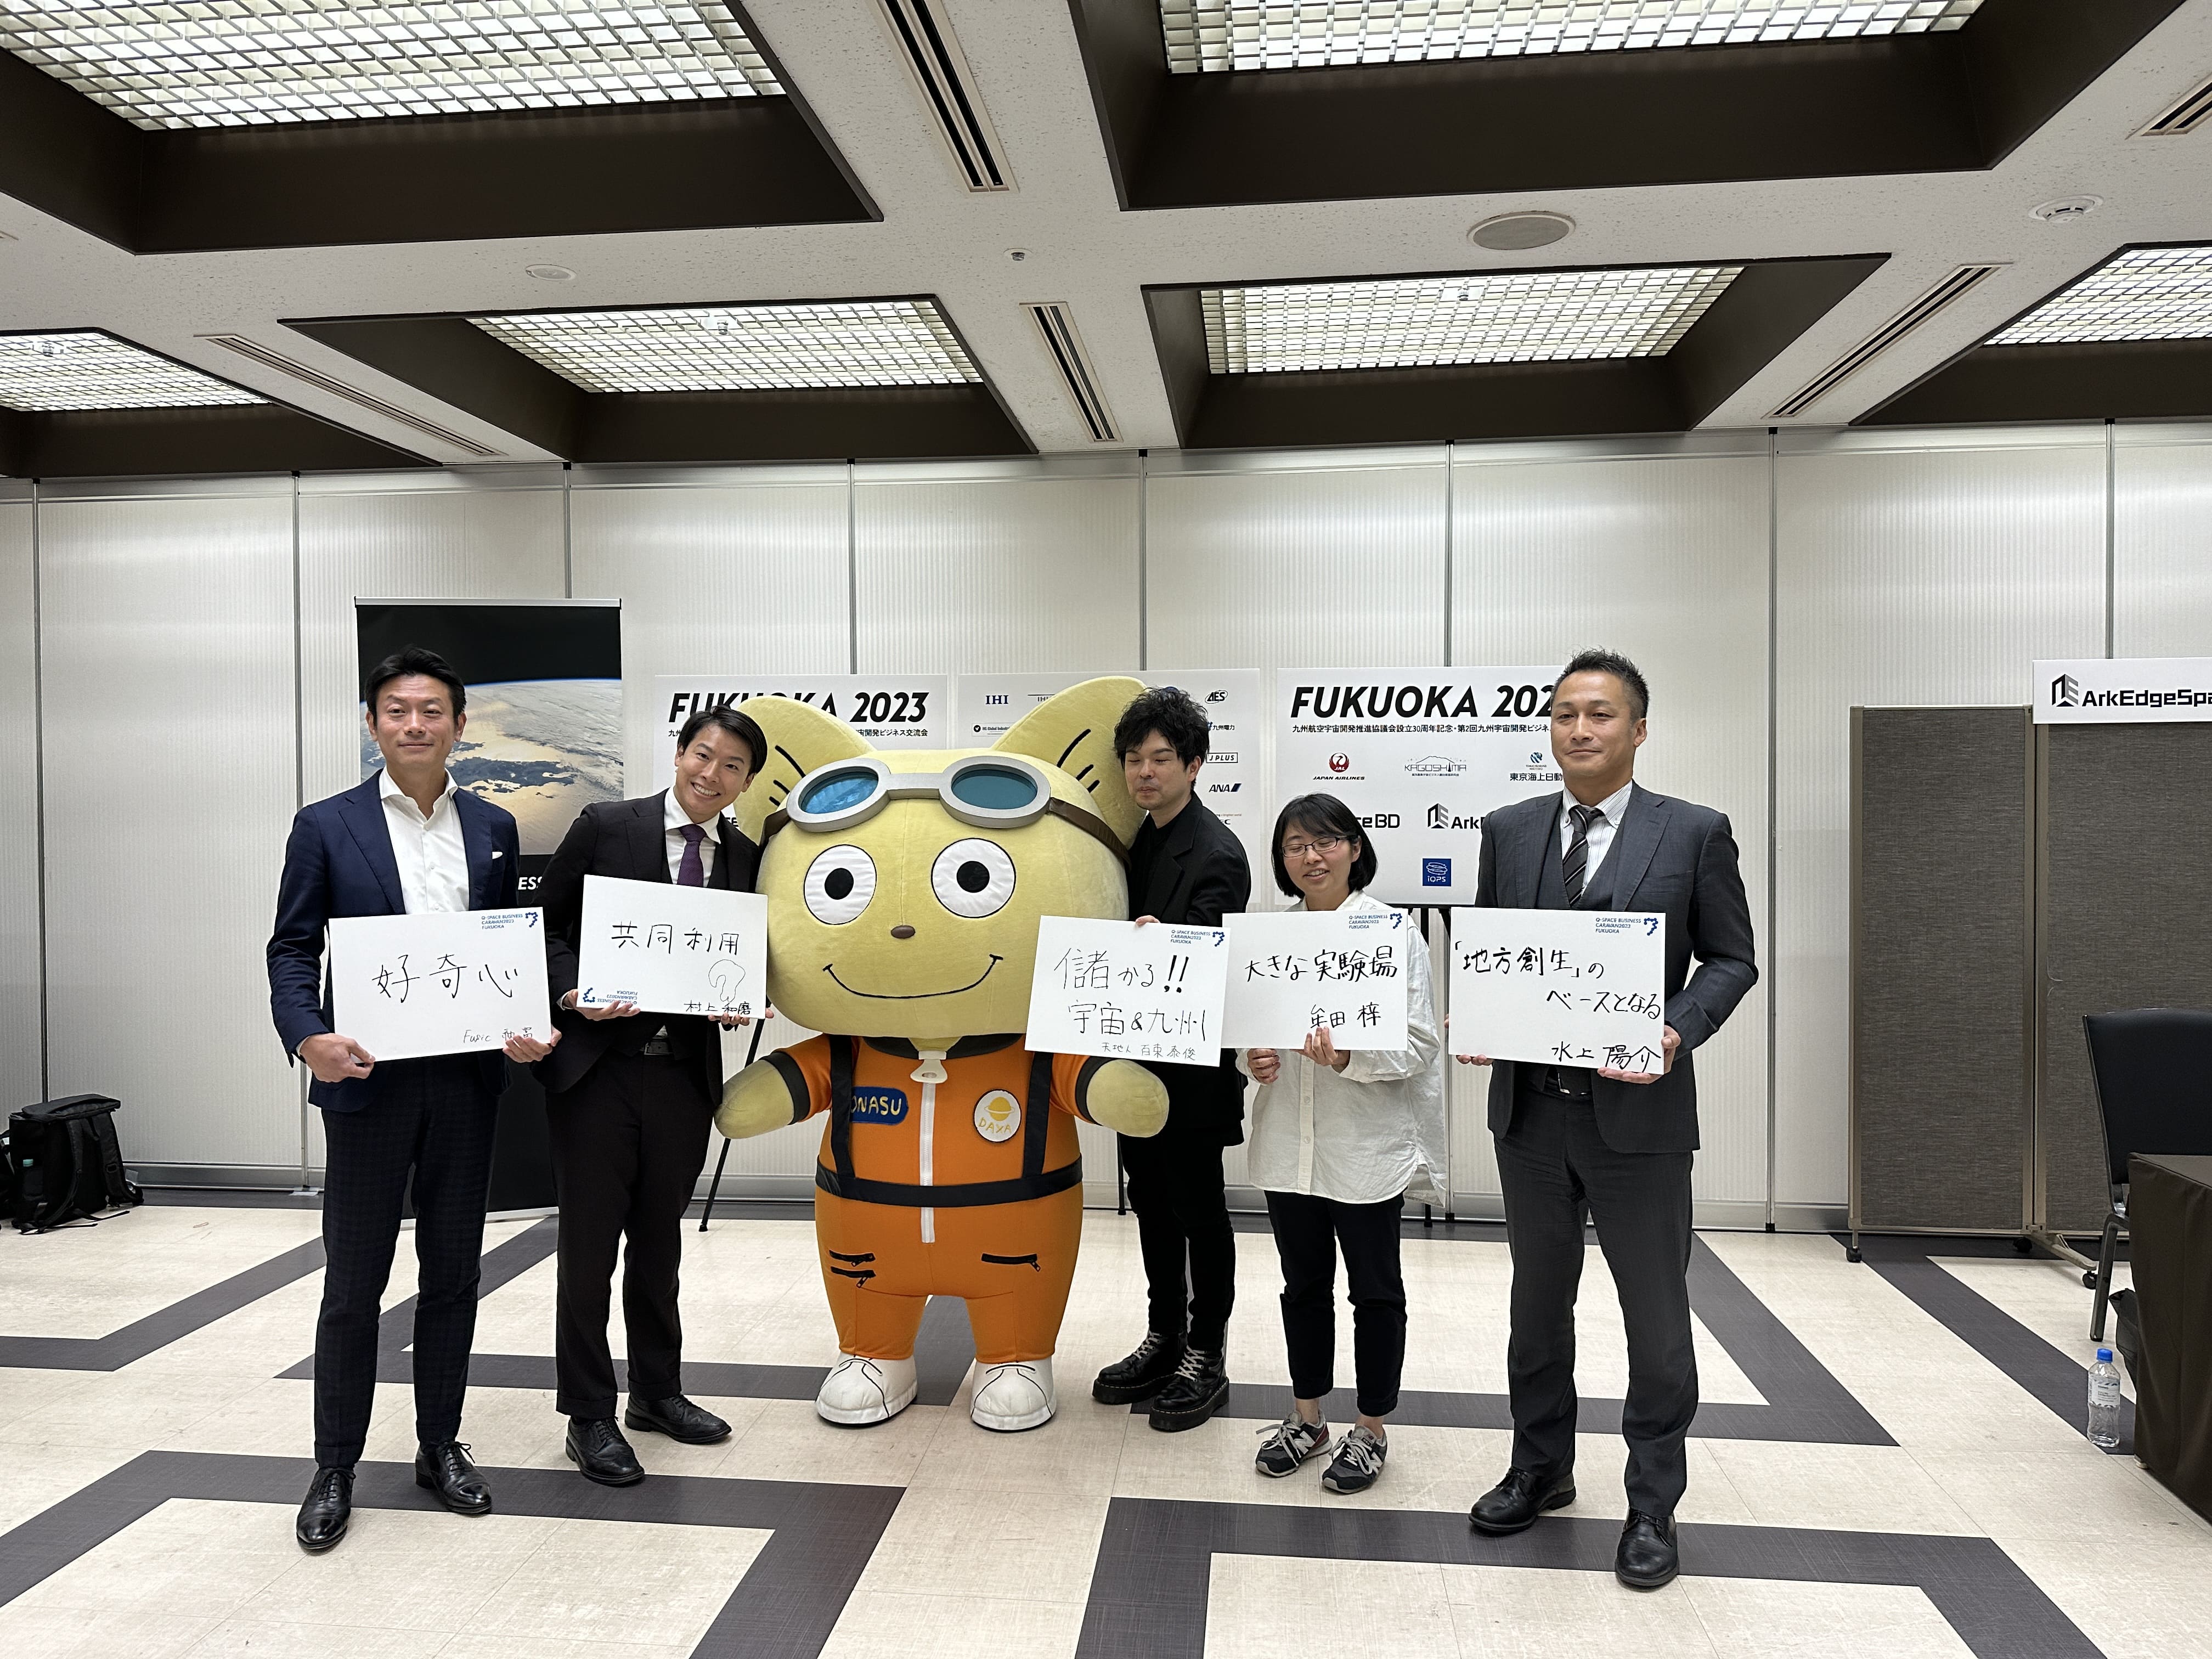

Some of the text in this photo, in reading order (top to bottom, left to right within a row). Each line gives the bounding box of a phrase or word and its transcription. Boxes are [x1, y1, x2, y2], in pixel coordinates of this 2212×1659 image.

[985, 695, 1009, 704] IHI
[1207, 692, 1225, 701] AES
[1290, 685, 1551, 718] FUKUOKA 202
[849, 692, 929, 723] 2023
[1293, 724, 1550, 733] 九州航空宇宙開発推進協議会設立30周年記念・第2回九州宇宙開発ビジネ
[1510, 772, 1563, 781] 東京海上日動
[1209, 784, 1230, 792] ANA
[1375, 814, 1400, 828] BD
[611, 920, 740, 956] 共同利用
[1245, 945, 1397, 983] 大きな実験場
[1454, 940, 1604, 979] 「地方創生」の
[371, 953, 518, 1003] 好奇心
[1546, 990, 1661, 1019] ベースとなる
[1068, 1000, 1206, 1041] 宇宙&九州
[463, 1030, 491, 1043] Fusic
[1102, 1042, 1131, 1053] 天地人
